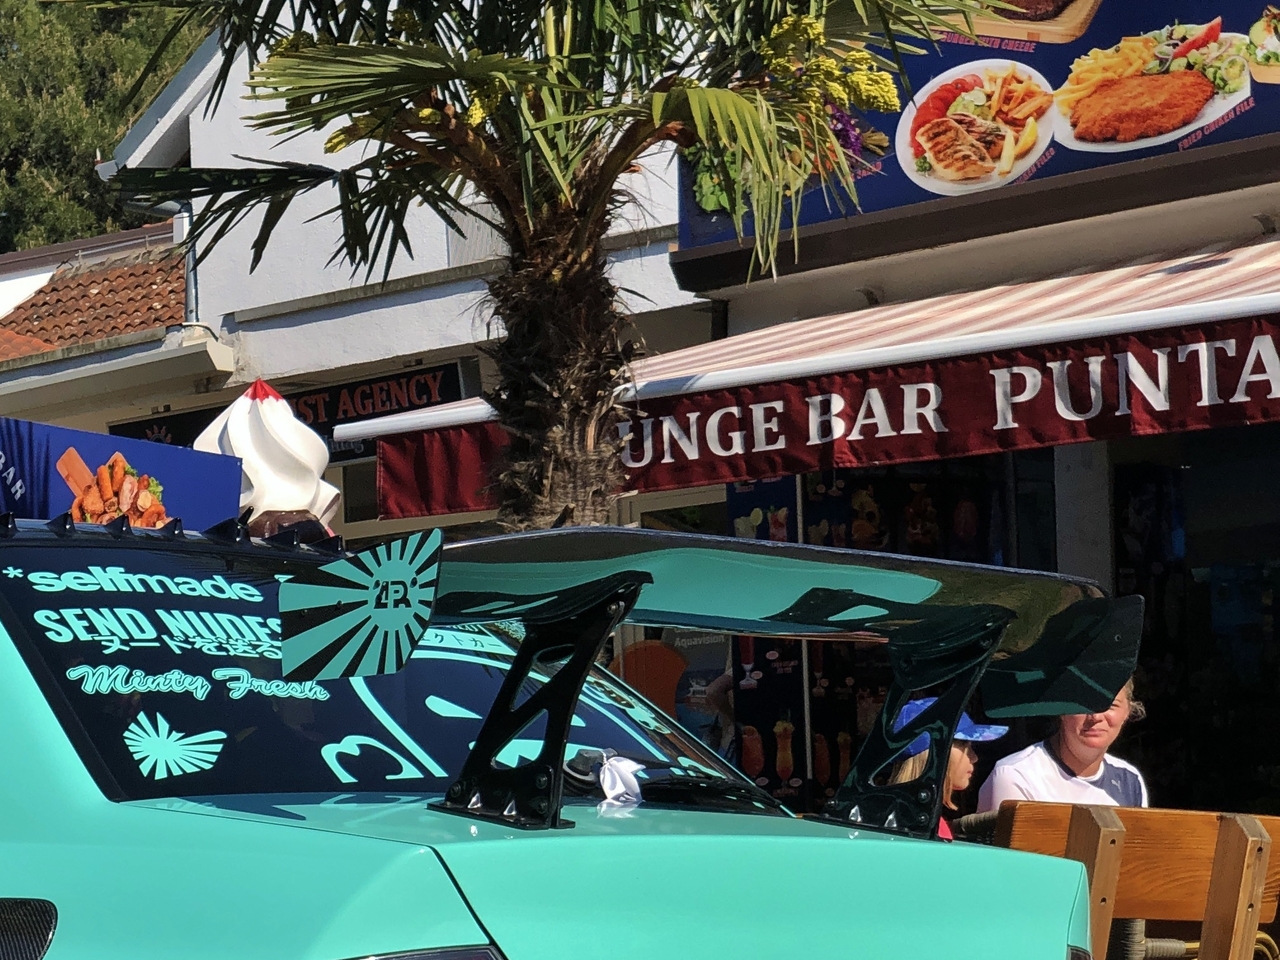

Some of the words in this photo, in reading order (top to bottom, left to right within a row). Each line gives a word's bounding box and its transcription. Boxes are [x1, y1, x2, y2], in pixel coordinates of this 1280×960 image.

[1178, 130, 1203, 152] FRIED
[1235, 96, 1256, 116] FILE
[336, 371, 444, 419] AGENCY
[620, 401, 787, 468] UNGE
[806, 382, 949, 446] BAR
[989, 334, 1280, 431] PUNTA
[33, 608, 157, 643] SEND
[674, 635, 726, 649] Aquavision
[66, 664, 212, 700] Minty
[212, 667, 331, 701] Fresh
